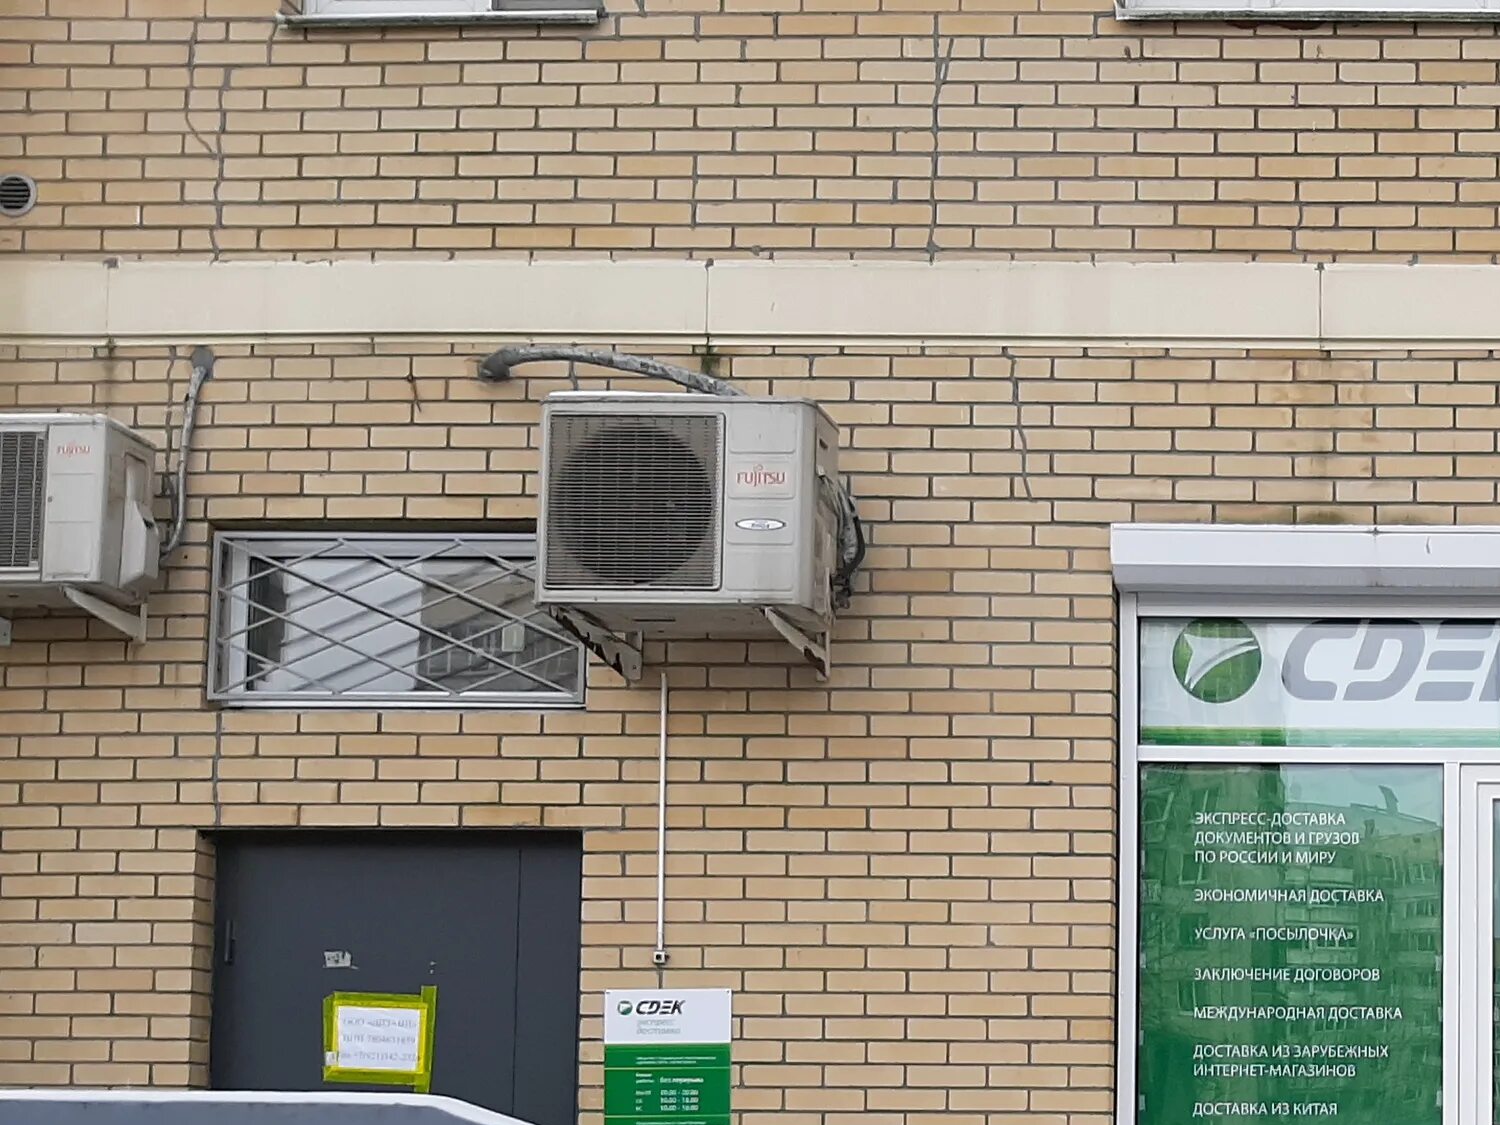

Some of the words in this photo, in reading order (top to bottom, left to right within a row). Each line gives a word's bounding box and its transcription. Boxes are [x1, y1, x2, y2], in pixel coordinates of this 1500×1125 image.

[736, 466, 786, 487] FUJITSU
[1194, 812, 1346, 827] ЭКСПРЕСС-ДОСТАВКА
[1194, 832, 1291, 846] ДОКУМЕНТОВ
[1295, 832, 1306, 845] И
[1309, 832, 1360, 845] ГРУЗОВ
[1194, 851, 1216, 864] ПО
[1220, 851, 1278, 864] РОССИИ
[1282, 851, 1293, 864] И
[1296, 851, 1336, 864] МИРУ
[1194, 889, 1306, 902] ЭКОНОМИЧНАЯ
[1309, 889, 1384, 903] ДОСТАВКА
[1194, 928, 1246, 941] УСЛУГА
[1194, 968, 1290, 981] ЗАКЛЮЧЕНИЕ
[1293, 968, 1380, 983] ДОГОВОРОВ
[636, 1000, 686, 1015] CDEK
[1194, 1006, 1325, 1021] МЕЖДУНАРОДНАЯ
[1328, 1007, 1402, 1021] ДОСТАВКА
[1193, 1045, 1268, 1059] ДОСТАВКА
[1272, 1045, 1290, 1058] ИЗ
[1293, 1045, 1388, 1058] ЗАРУБЕЖНЫХ
[1194, 1064, 1356, 1077] ИНТЕРНЕТ-МАГАЗИНОВ
[1193, 1103, 1268, 1117] ДОСТАВКА
[1271, 1103, 1290, 1115] ИЗ
[1293, 1103, 1338, 1115] КИТАЯ
